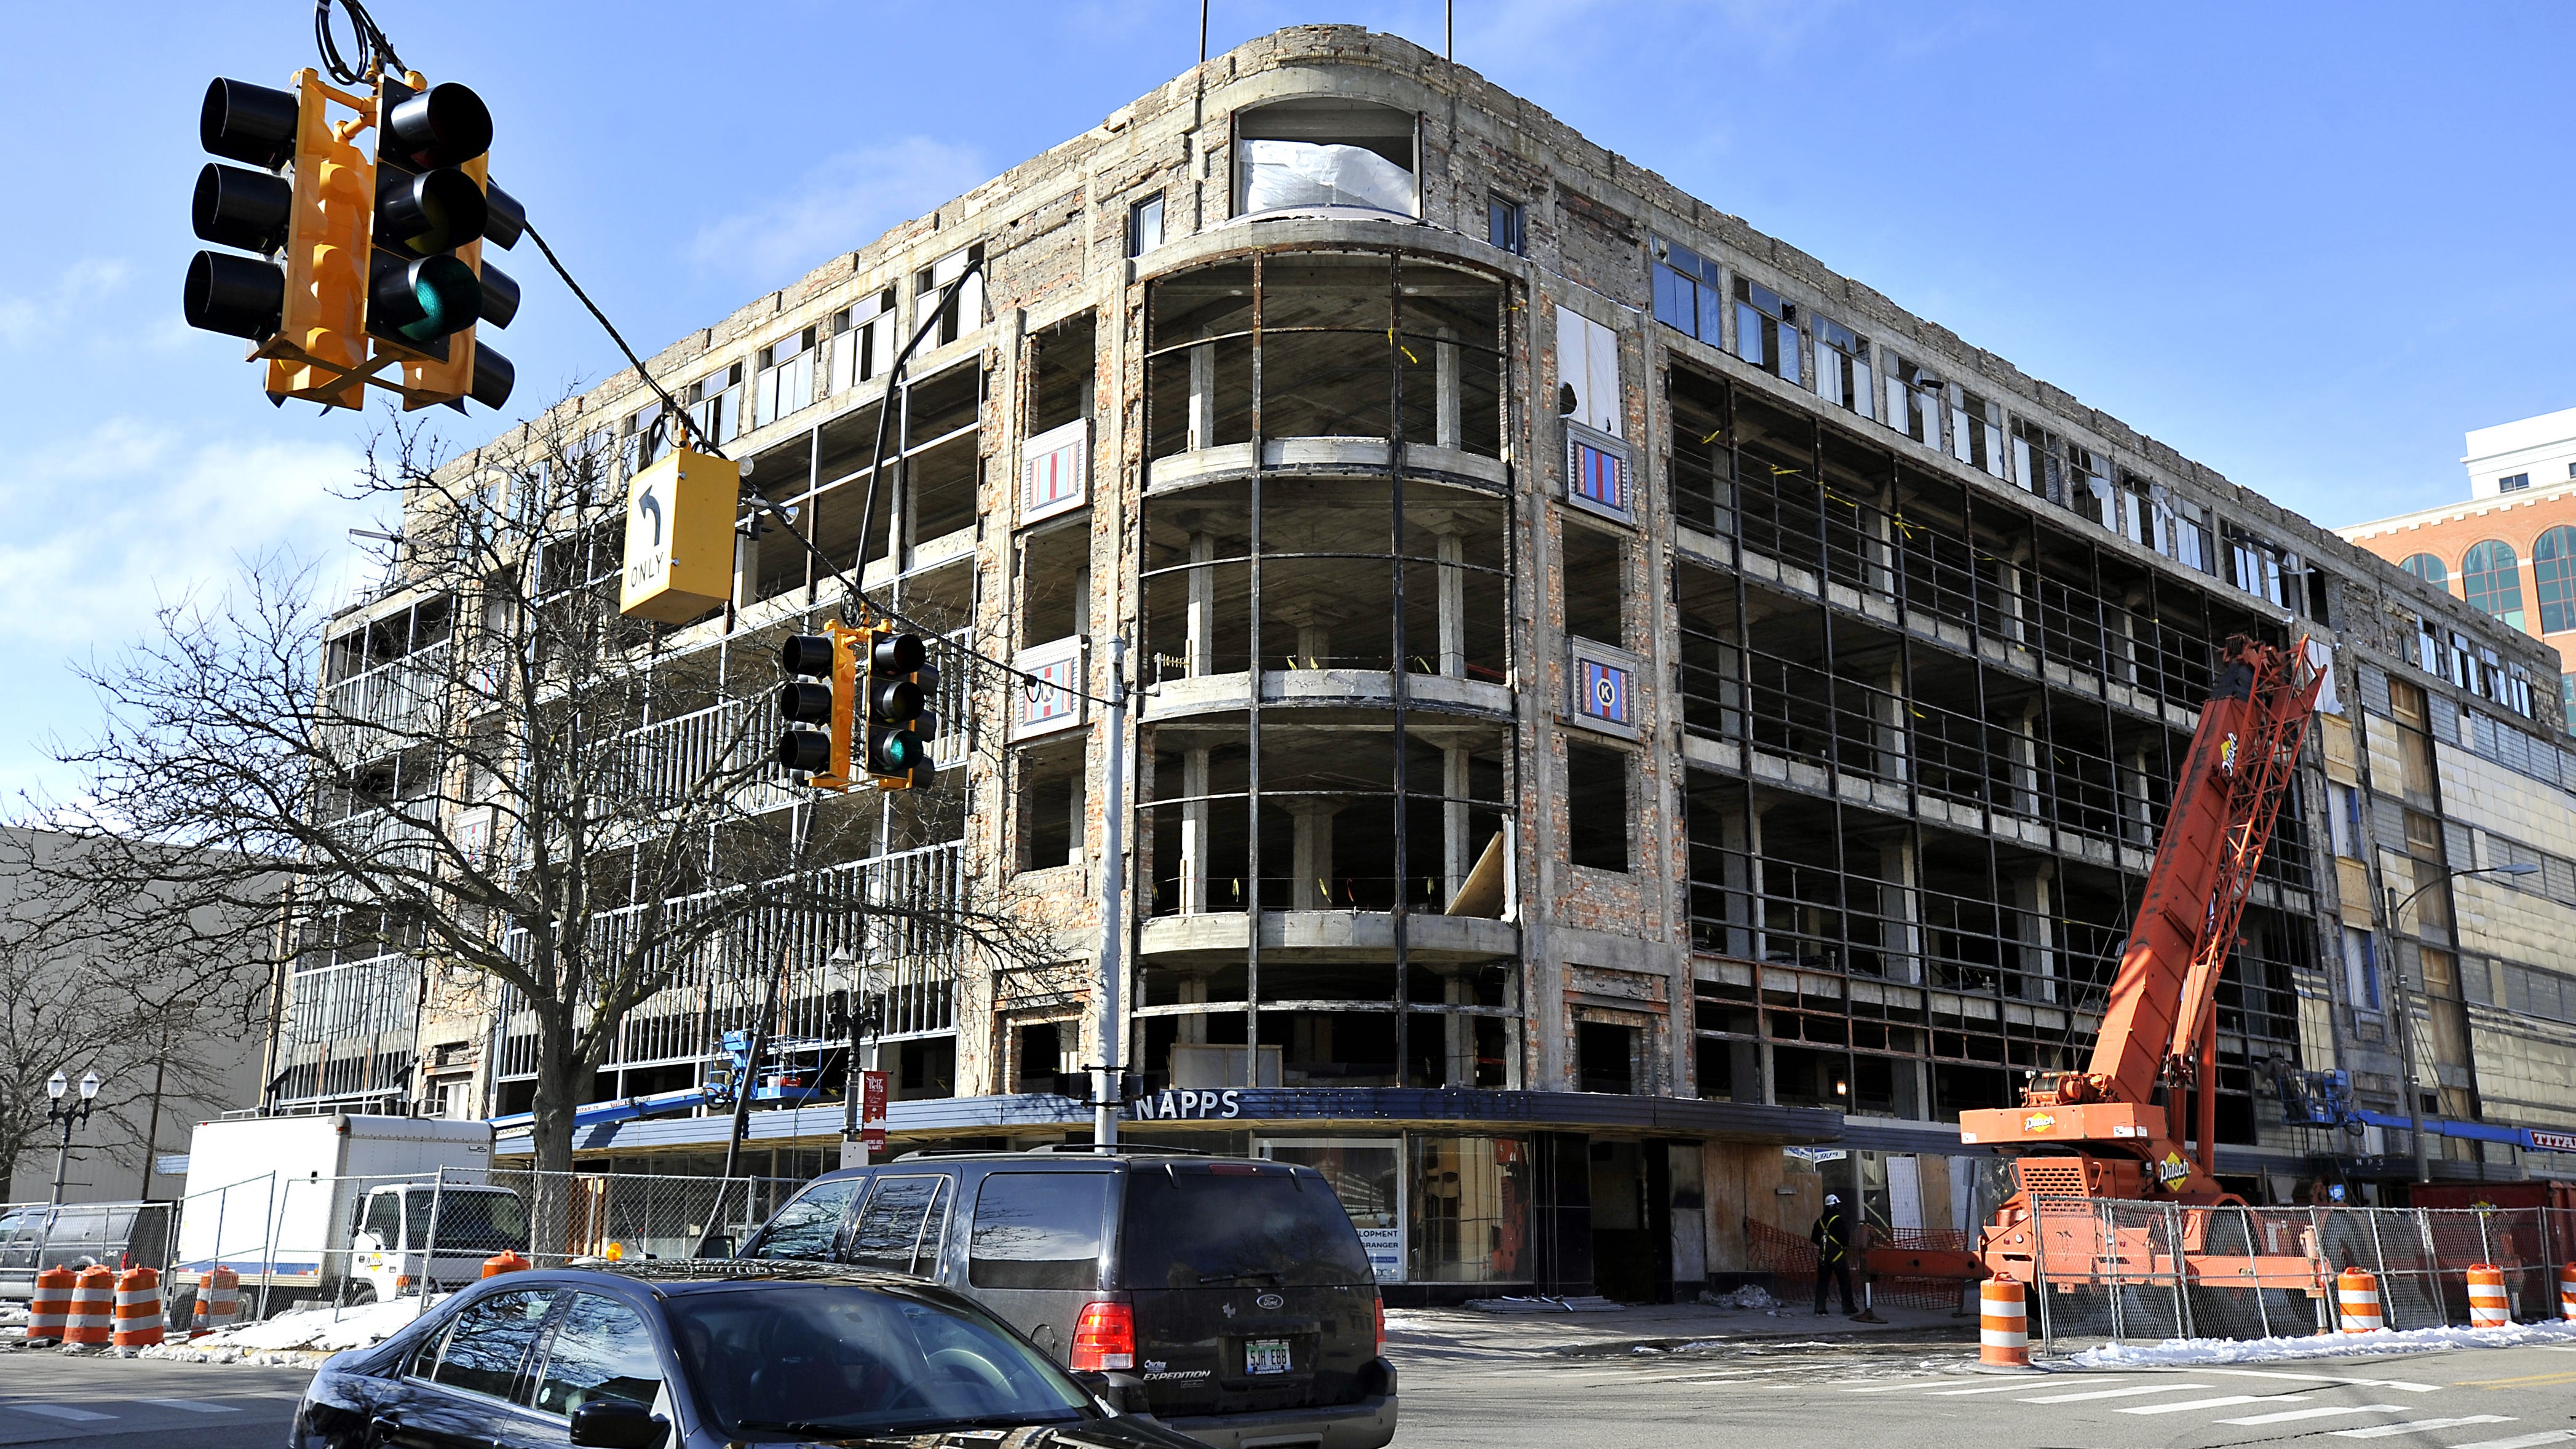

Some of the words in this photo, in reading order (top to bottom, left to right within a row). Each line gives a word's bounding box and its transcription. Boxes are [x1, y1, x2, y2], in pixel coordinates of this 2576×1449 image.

[631, 551, 664, 587] ONLY
[1601, 685, 1610, 700] K
[1135, 1090, 1239, 1121] NAPPS
[2534, 1133, 2576, 1148] TITA
[2160, 1158, 2189, 1183] Pitsch
[1143, 1370, 1211, 1381] EXPEDITION
